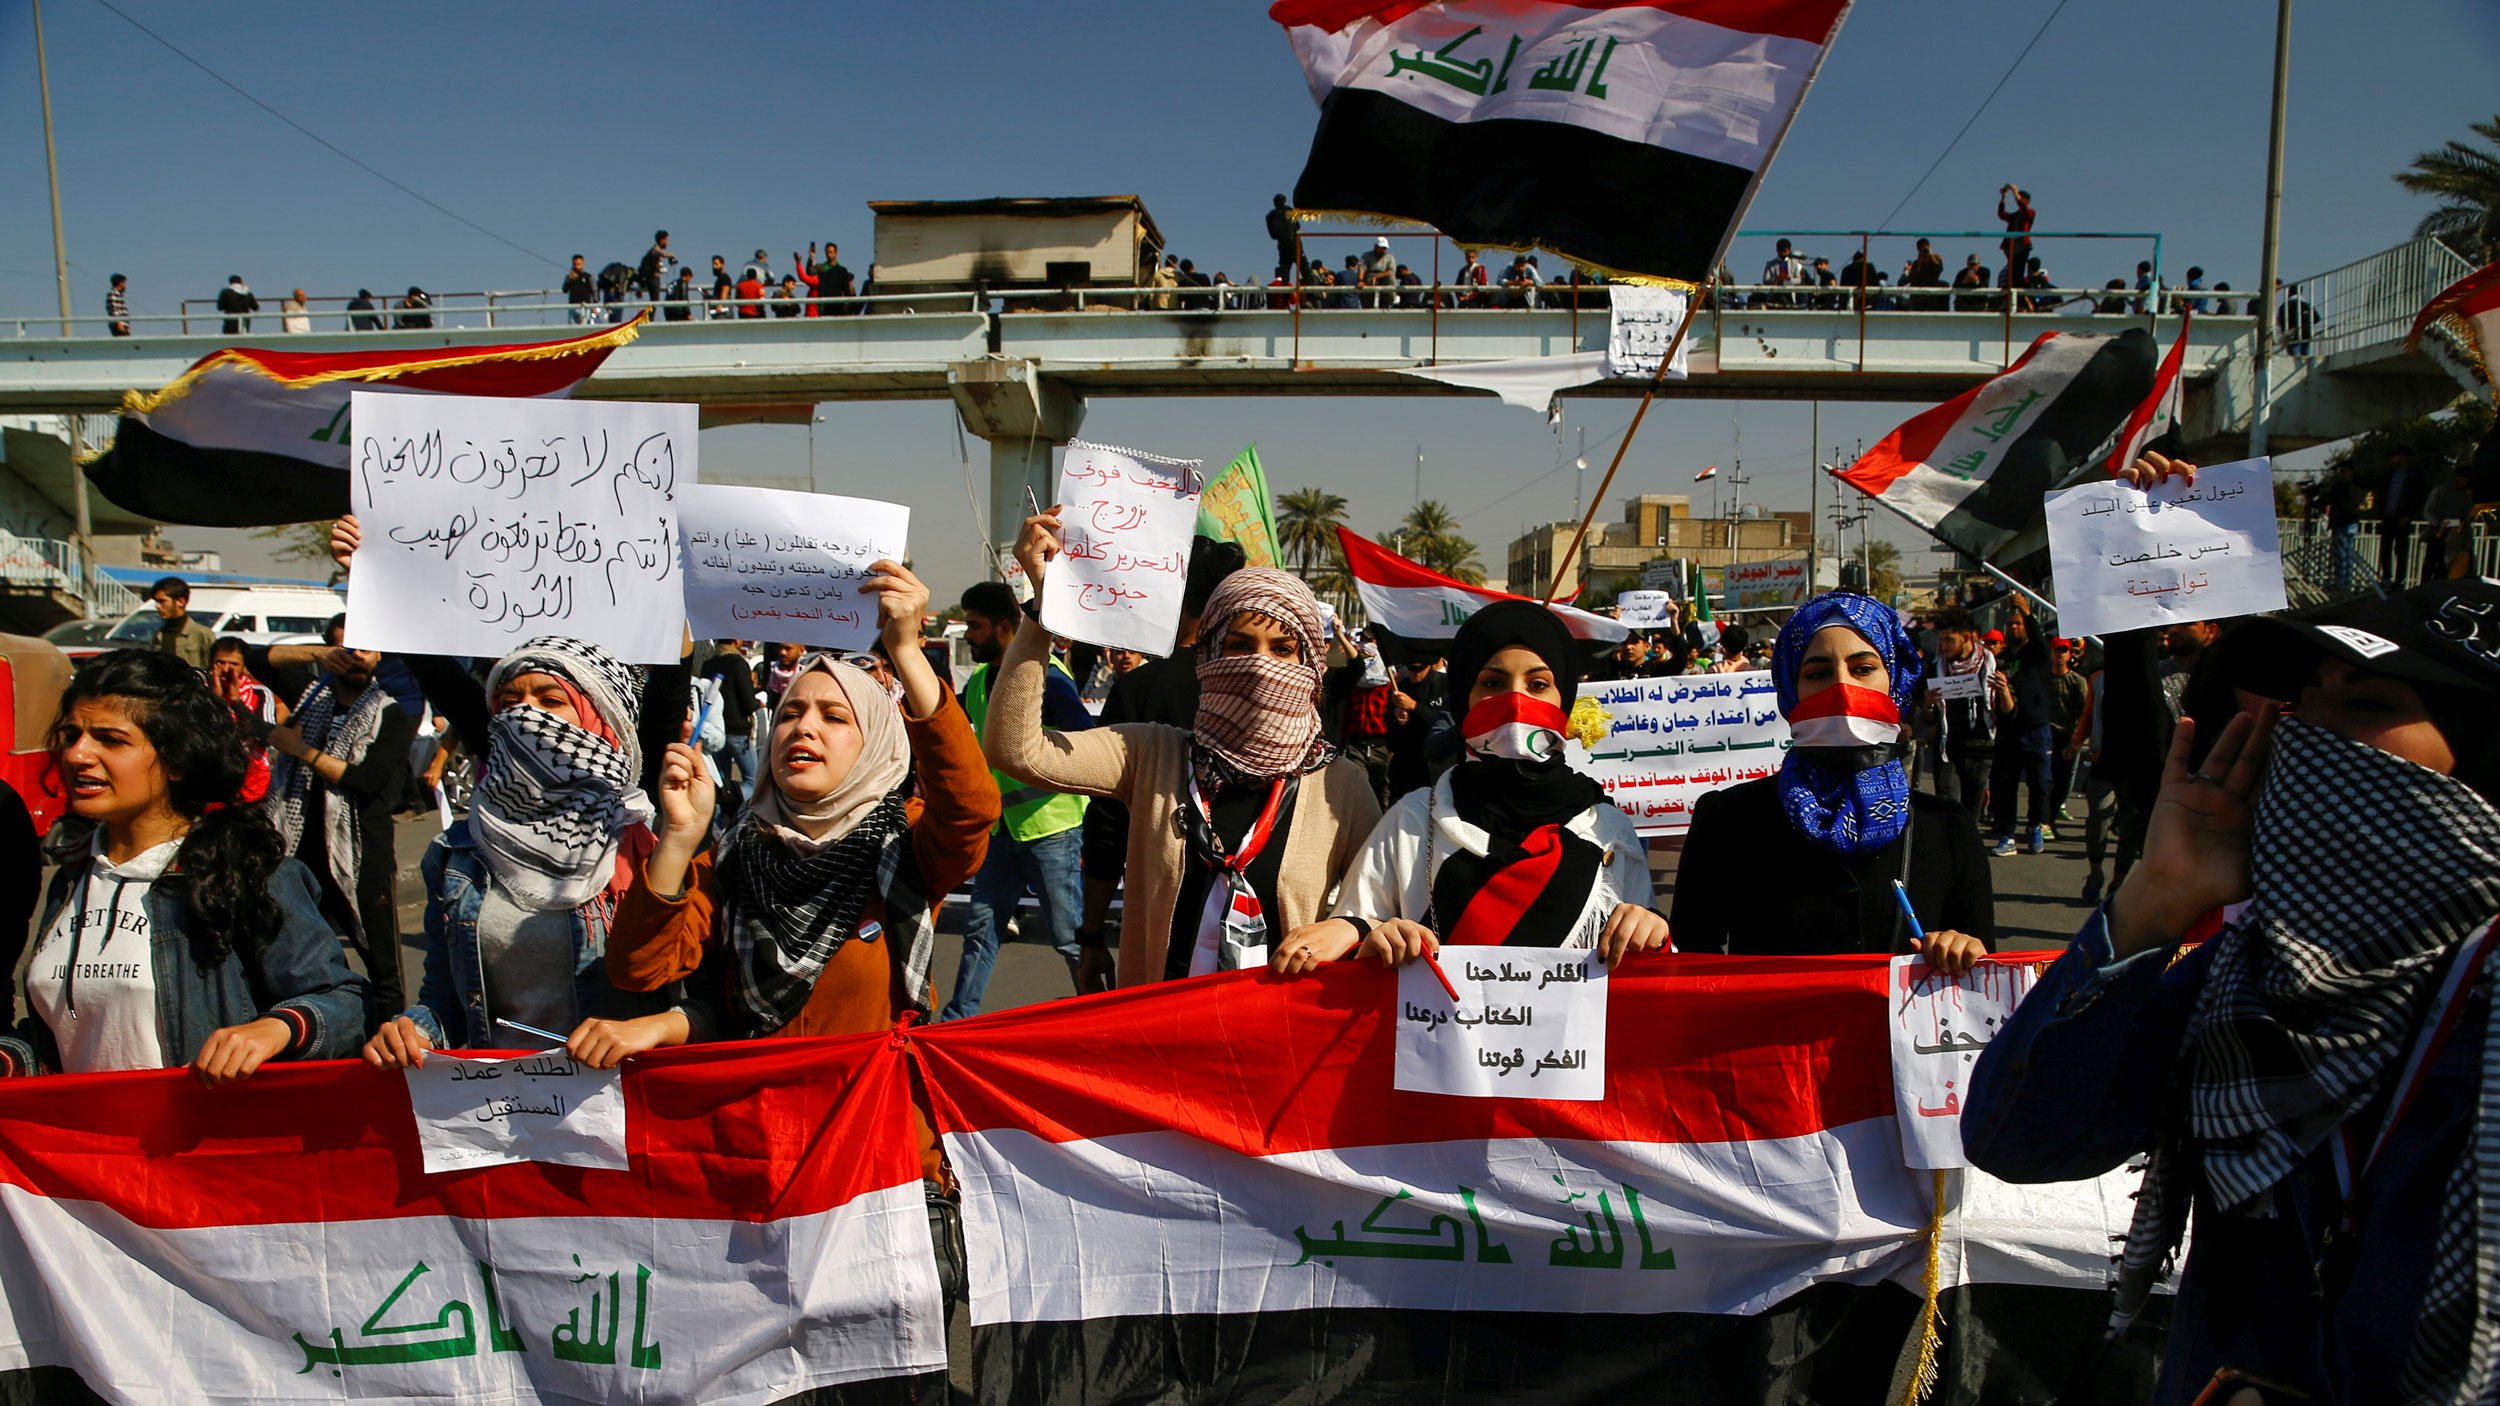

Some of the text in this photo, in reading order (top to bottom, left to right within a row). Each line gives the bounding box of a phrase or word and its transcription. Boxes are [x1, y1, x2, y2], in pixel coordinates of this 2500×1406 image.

[450, 436, 567, 500] تحرقون
[570, 429, 608, 487] لا
[613, 432, 674, 516] إنكم
[2206, 481, 2245, 502] ذيول
[2081, 498, 2120, 517] البلد
[690, 531, 720, 548] وانتم
[775, 535, 818, 553] تقابلون
[822, 541, 850, 553] وجه
[389, 506, 671, 606] أنتم فقط ترفعون لهيب
[1062, 528, 1185, 581] التحرير كلها
[2109, 541, 2230, 567] بس خلصت
[737, 560, 785, 576] وتبيدون
[788, 562, 825, 577] مدينته
[466, 570, 573, 633] الثورة
[742, 583, 843, 600] يامن تدعون حبه
[785, 607, 823, 620] النجف
[1648, 685, 1663, 702] له
[1737, 677, 1777, 699] تنكر
[1611, 707, 1777, 738] من اعتداء جبان وغاشم
[1618, 772, 1686, 790] بمساندتنا
[1689, 767, 1731, 786] الموقف
[1643, 798, 1685, 818] تحقيق
[1465, 961, 1589, 991] القلم سلاحنا
[1405, 1001, 1532, 1032] الكتاب درعنا
[451, 1056, 580, 1082] الطلبة عماد
[1478, 1047, 1587, 1078] الفكر قوتنا
[476, 1095, 566, 1122] المستقبل
[1549, 1174, 1677, 1271] الله
[551, 1253, 662, 1370] الله
